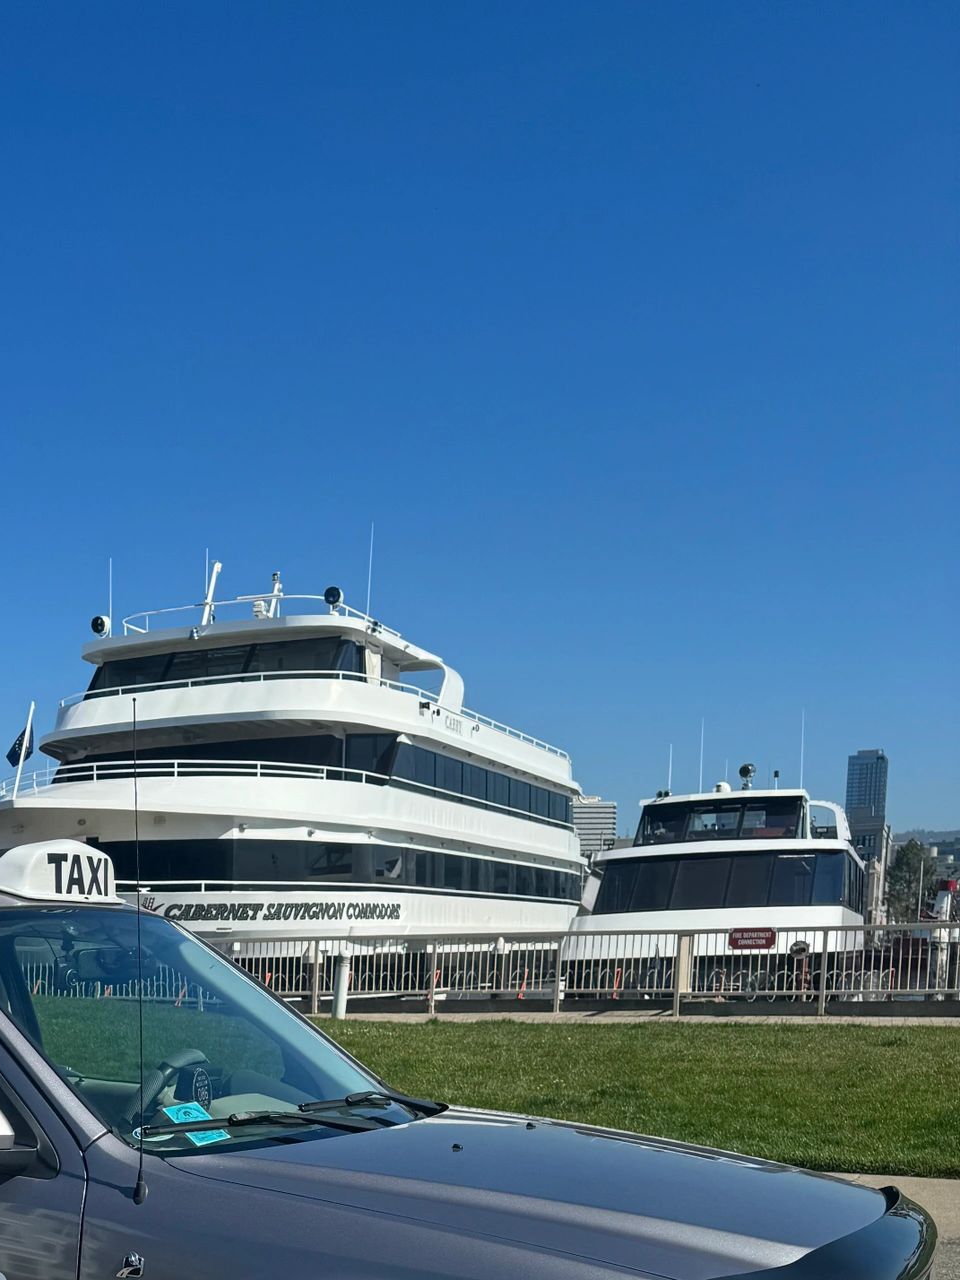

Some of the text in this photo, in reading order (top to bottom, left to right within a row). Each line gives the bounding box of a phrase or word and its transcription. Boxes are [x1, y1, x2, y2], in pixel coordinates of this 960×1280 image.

[47, 852, 108, 897] TAXI
[164, 903, 264, 921] CABERNET
[263, 903, 345, 921] SAUVIGNON
